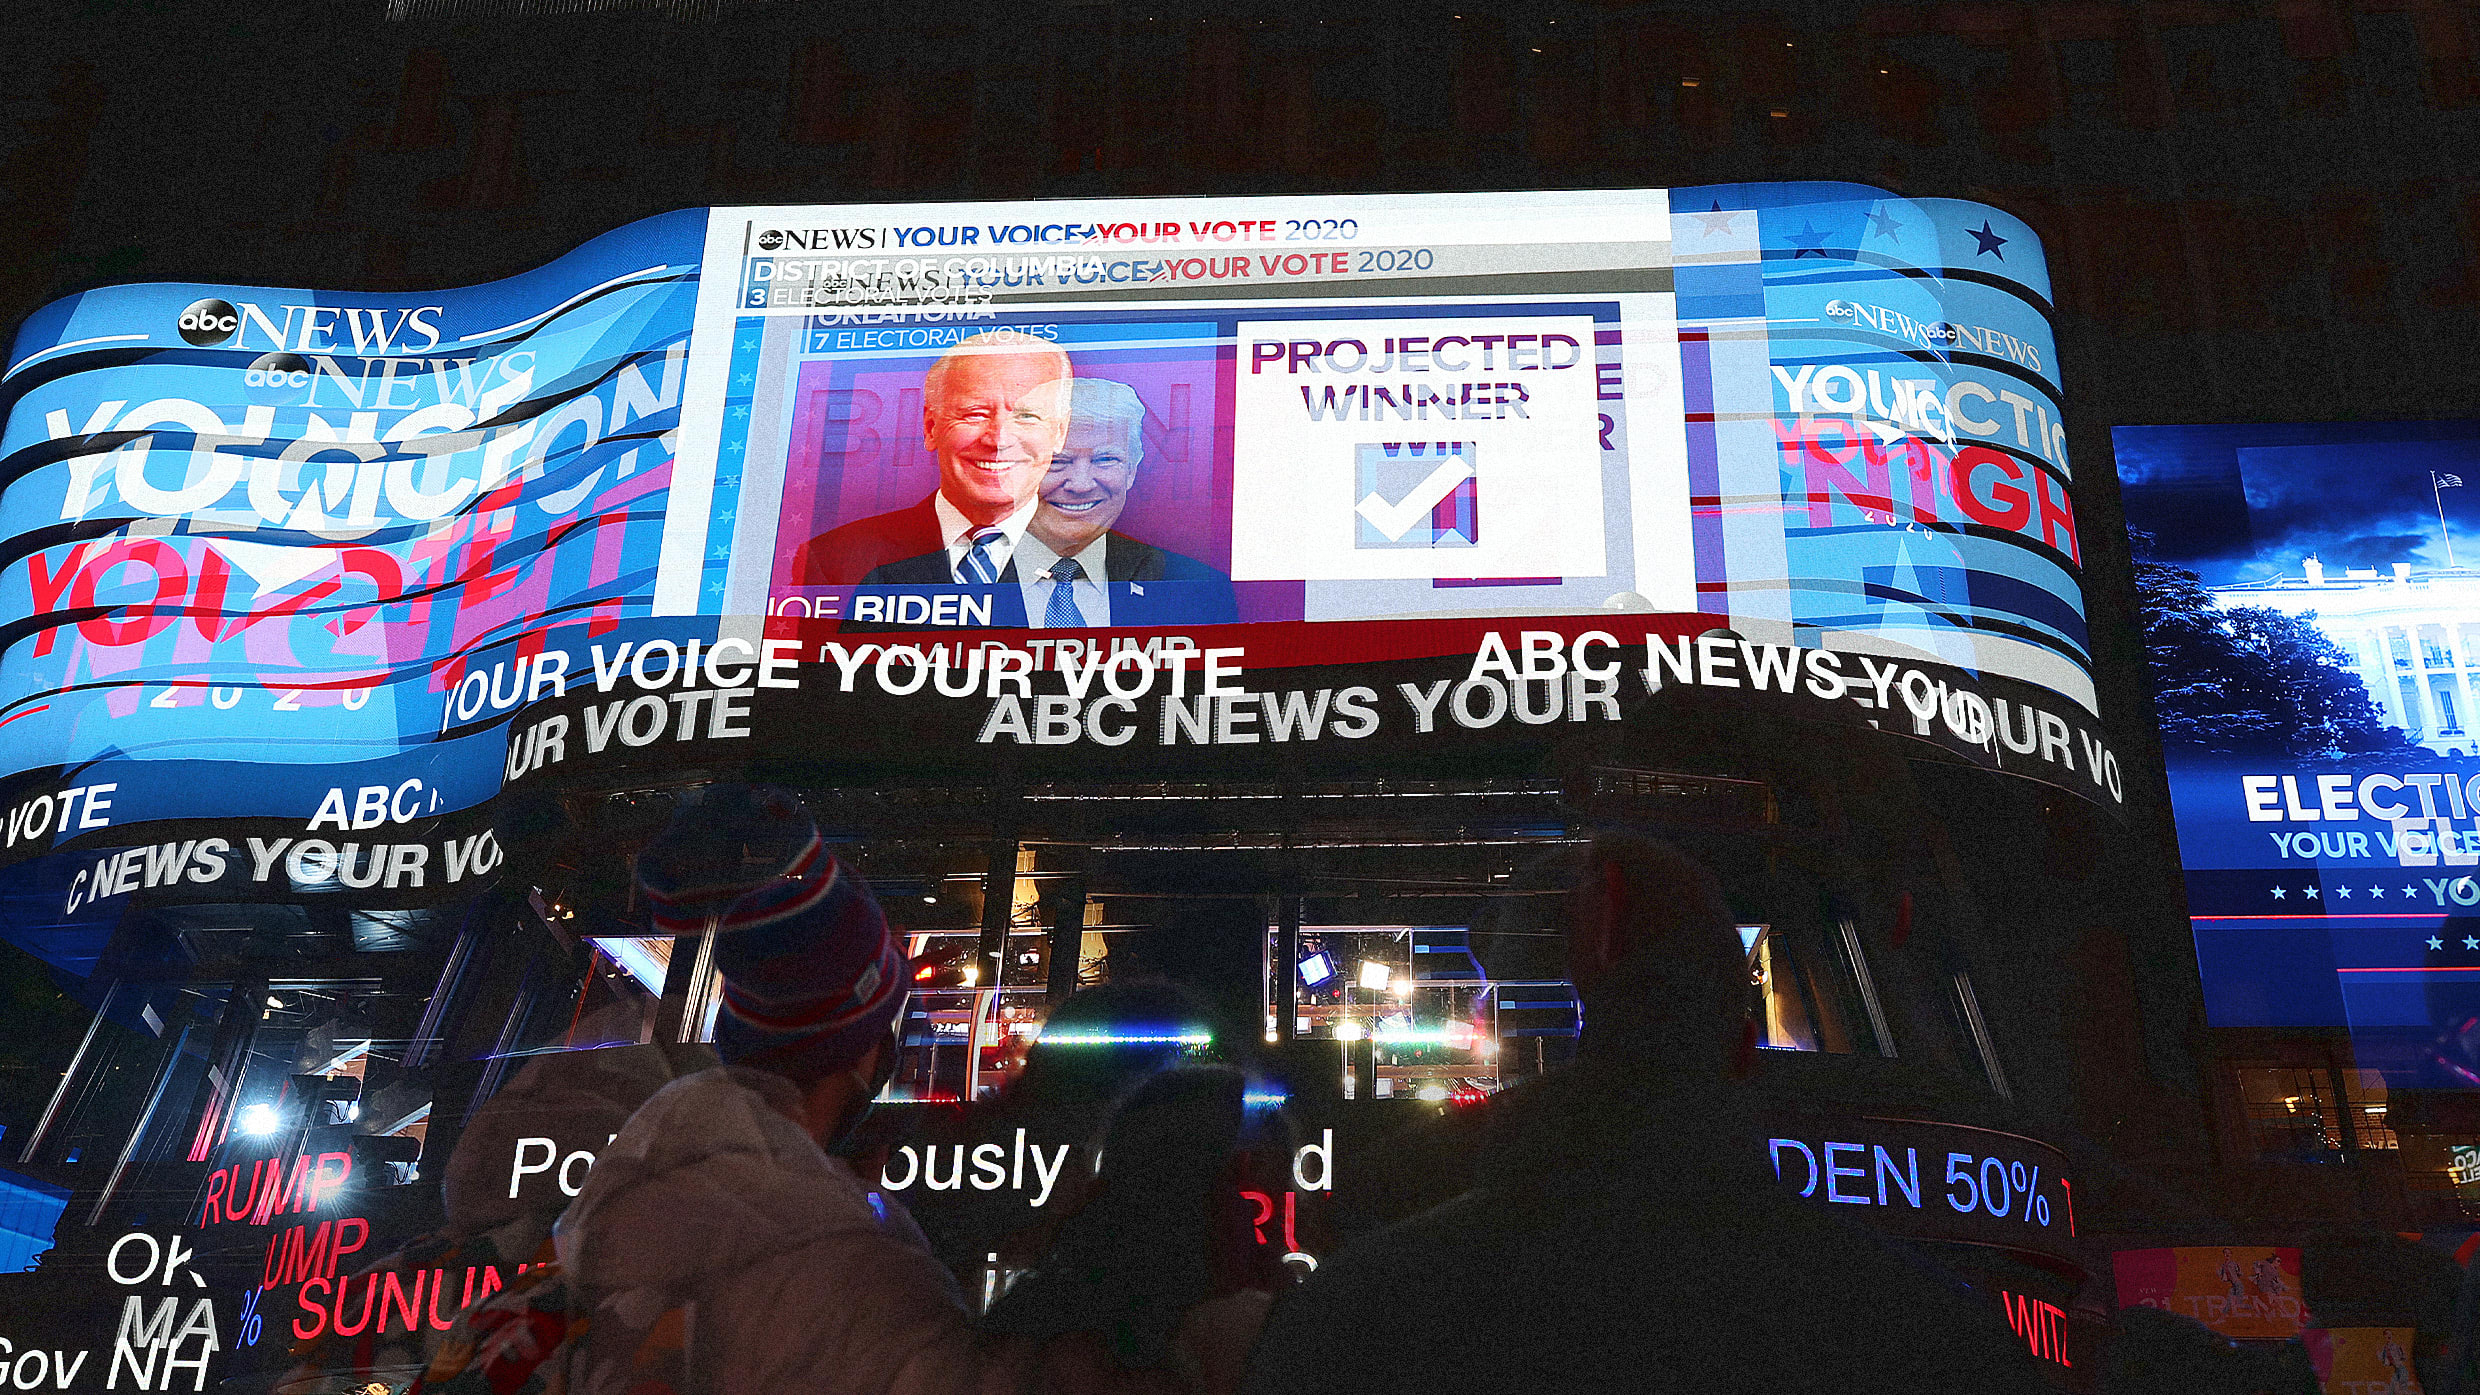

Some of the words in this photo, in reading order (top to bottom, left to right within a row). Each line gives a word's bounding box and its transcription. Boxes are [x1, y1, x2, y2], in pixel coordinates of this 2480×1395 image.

[784, 227, 876, 250] NEWS
[893, 226, 981, 248] YOUR
[989, 223, 1082, 246] VOICE
[1096, 222, 1181, 244] YOUR
[1188, 220, 1277, 242] VOTE
[1285, 219, 1359, 241] 2020
[753, 258, 892, 284] DISTRICT
[894, 257, 940, 280] OF
[942, 254, 1108, 280] COLUMBIA
[1165, 256, 1251, 282] YOUR
[1259, 252, 1349, 277] VOTE
[1357, 248, 1434, 273] 2020
[750, 288, 766, 306] 3
[774, 286, 910, 306] ELECTORAL
[914, 284, 995, 304] VOTES
[179, 312, 237, 334] abc
[236, 301, 443, 354] NEWS
[813, 333, 828, 350] 7
[836, 328, 970, 349] ELECTORAL
[979, 324, 1061, 345] VOTES
[1850, 302, 1933, 350] NEWS
[1927, 327, 1956, 340] abc
[1954, 323, 2042, 373] NEWS
[1251, 333, 1582, 375] PROJECTED
[307, 350, 537, 411] NEWS
[1300, 381, 1531, 422] WINNER
[854, 593, 993, 627] BIDEN
[441, 648, 570, 734] YOUR
[590, 637, 804, 694] VOICE
[826, 641, 1037, 699] YOUR
[1057, 647, 1245, 700] VOTE
[1467, 630, 1622, 683] ABC
[1644, 632, 1845, 699] NEWS
[583, 687, 756, 753] VOTE
[977, 692, 1137, 747] ABC
[1158, 686, 1381, 746] NEWS
[1396, 670, 1622, 734] YOUR
[6, 782, 118, 849] VOTE
[306, 778, 423, 832] ABC
[2269, 831, 2372, 859] YOUR
[2375, 831, 2480, 858] VOICE
[87, 837, 233, 904] NEWS
[245, 836, 429, 889] YOUR
[1945, 1151, 2050, 1227] 50%
[114, 1295, 220, 1352] MA
[106, 1337, 213, 1392] NH
